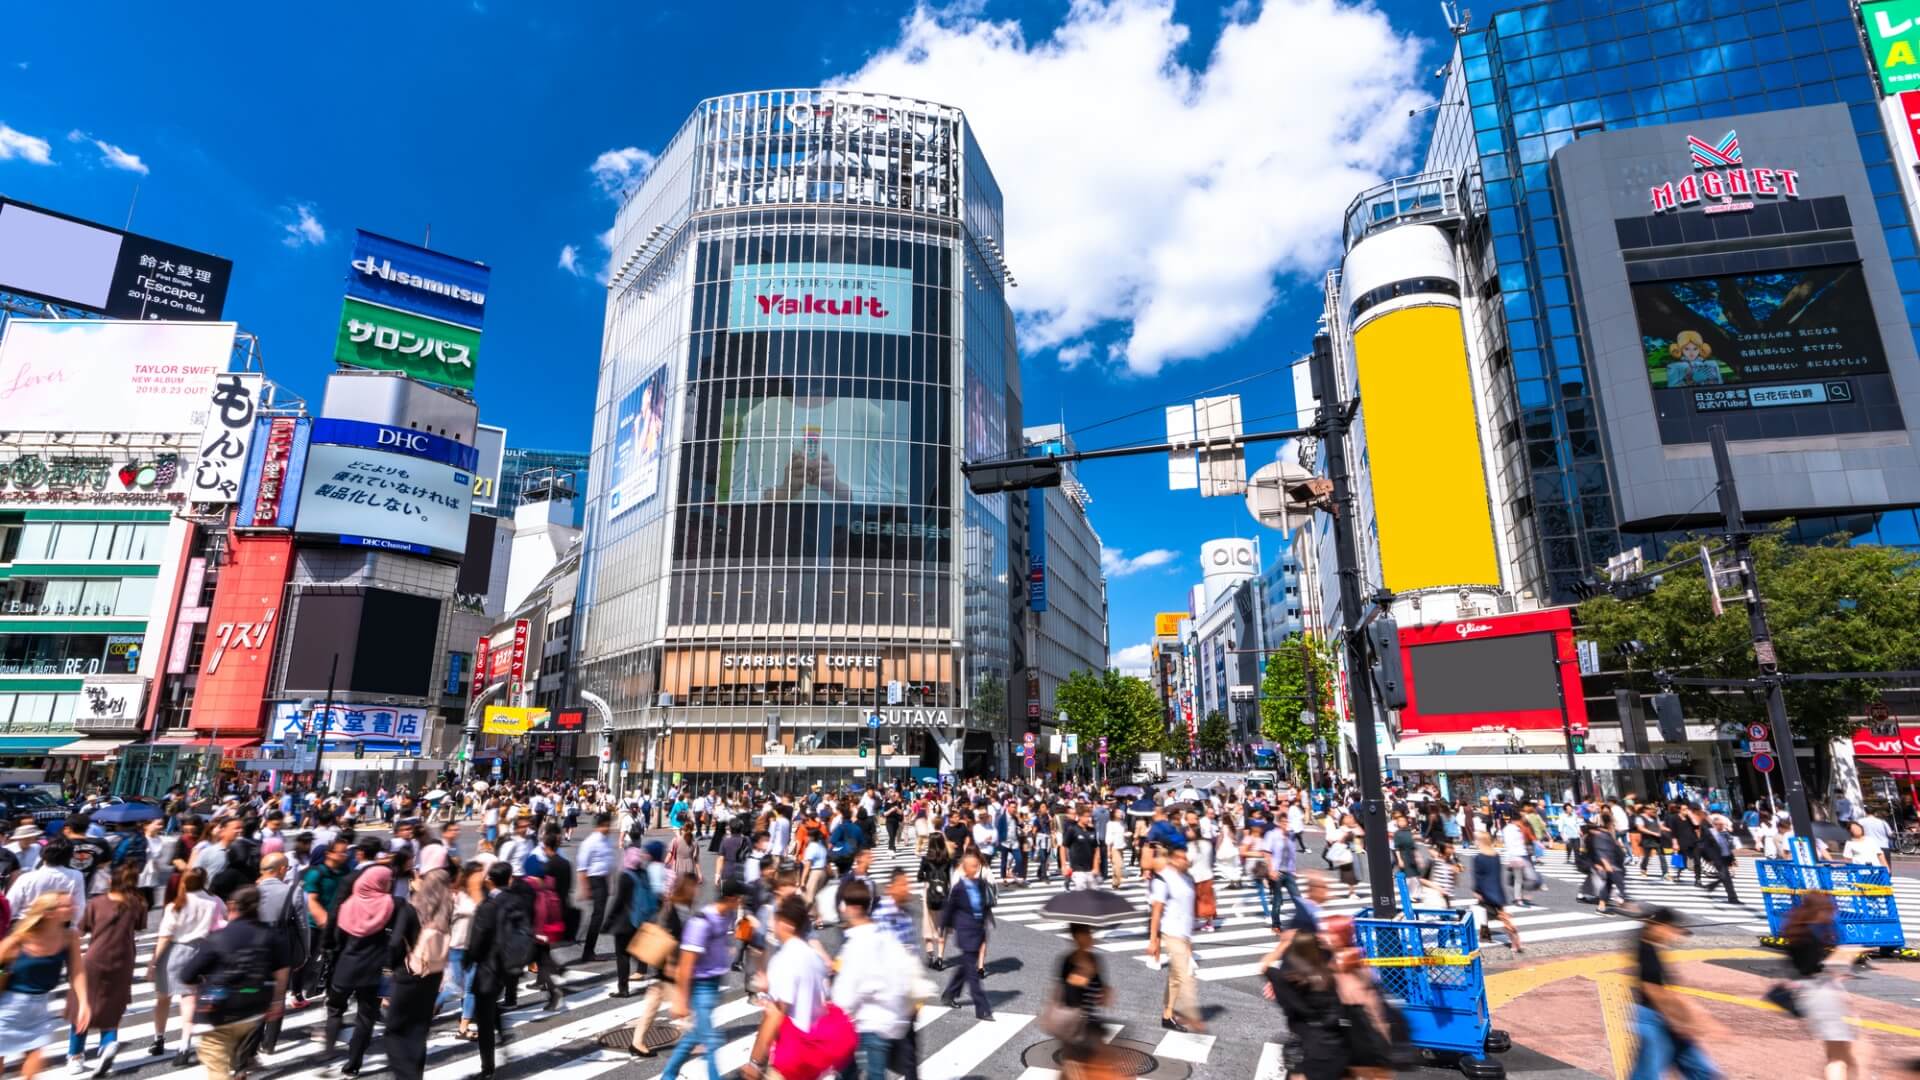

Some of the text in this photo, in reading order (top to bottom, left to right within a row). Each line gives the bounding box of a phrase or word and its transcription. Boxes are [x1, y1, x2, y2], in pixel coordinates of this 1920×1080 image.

[1651, 168, 1799, 213] MAGNET
[139, 254, 212, 283] 鈴木愛理
[352, 255, 485, 305] Hisamitsu
[172, 277, 193, 287] Single
[128, 290, 206, 314] 2019.9.4 On Sale
[753, 294, 889, 318] Yakult
[347, 318, 472, 368] サロンパス
[1740, 347, 1795, 358] 名前も知らない
[135, 365, 218, 375] TAYLOR SWIFT
[1744, 362, 1799, 373] 名前も知らない
[1, 362, 70, 399] Lover
[132, 376, 185, 384] NEW ALBUM
[1695, 389, 1748, 401] 日立の家電
[196, 375, 254, 499] もんじゃ
[376, 428, 429, 452] DHC
[347, 461, 410, 479] どこよりも
[331, 471, 461, 510] 優れていなければ
[314, 484, 429, 522] 製品化しない。
[362, 538, 412, 550] DHC Channel
[1011, 493, 1025, 675] UTAYA
[206, 607, 276, 675] クスリ
[1456, 623, 1493, 638] Glico
[513, 626, 526, 670] カラオケ
[34, 665, 58, 674] DARTS
[724, 655, 881, 668] STARBUCKS COFFEE
[283, 710, 418, 734] 大盛堂書店
[863, 709, 949, 725] TSUTAYA
